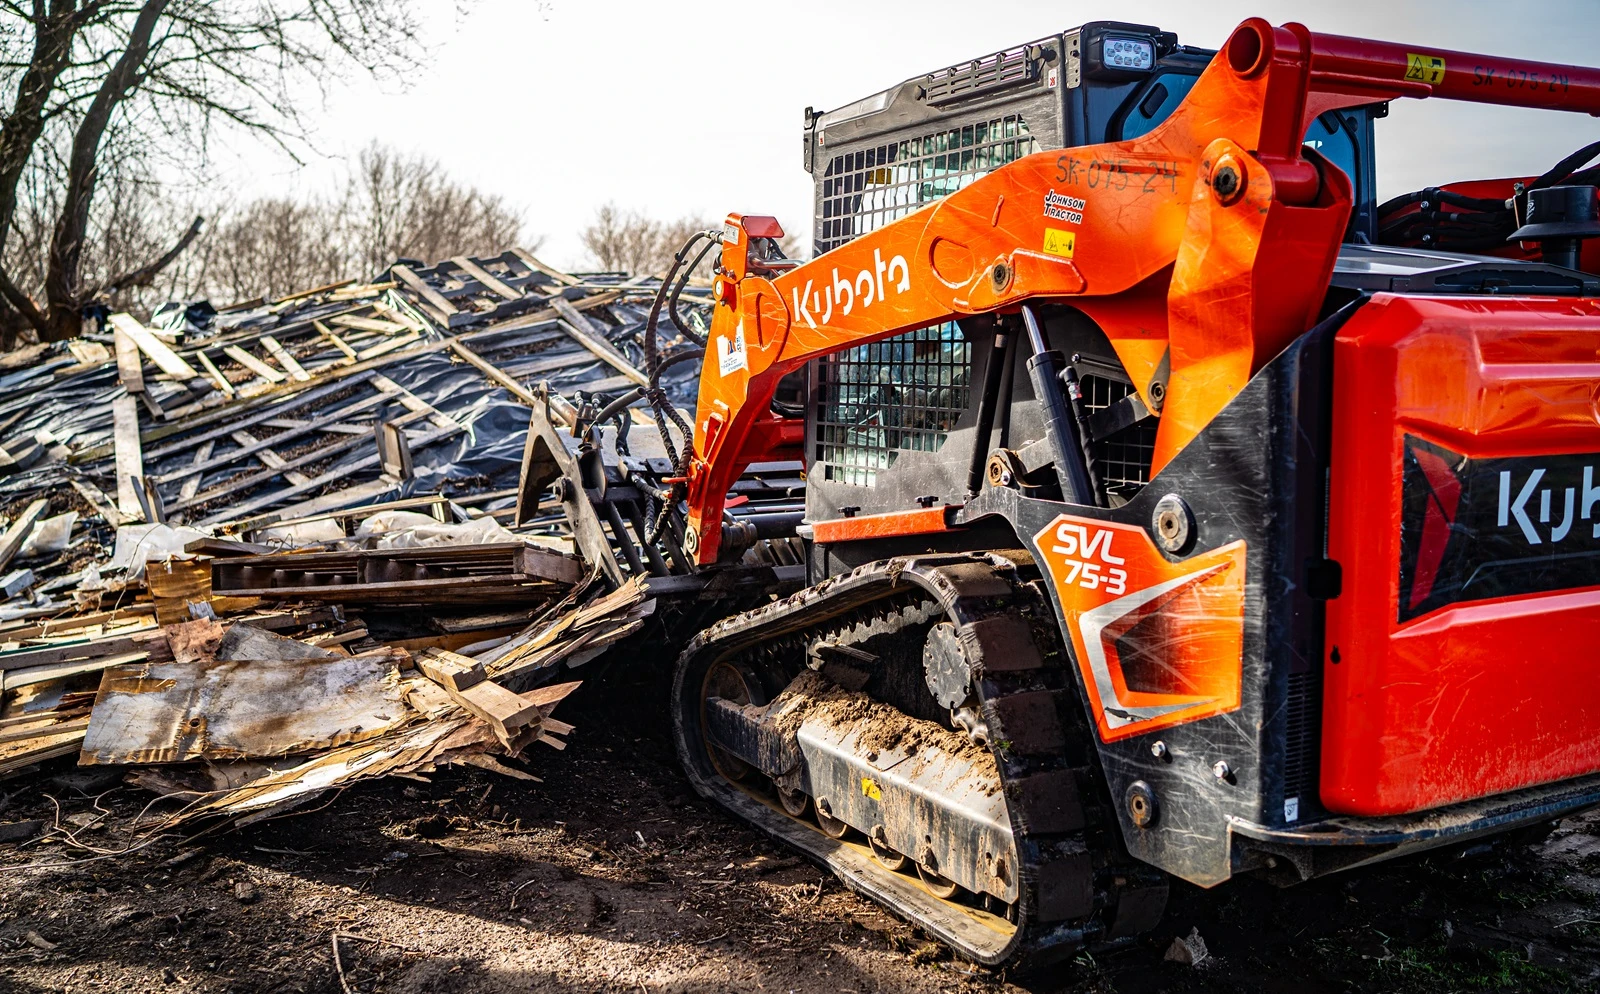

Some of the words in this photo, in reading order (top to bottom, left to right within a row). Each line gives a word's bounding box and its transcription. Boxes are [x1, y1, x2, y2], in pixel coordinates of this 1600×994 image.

[1472, 66, 1569, 92] SK-075-24
[1056, 156, 1177, 193] SK-075-24
[1045, 190, 1084, 210] JOHNSON
[1045, 204, 1082, 223] TRACTOR
[793, 248, 910, 329] Kubota
[1052, 523, 1125, 565] SVL
[1064, 559, 1128, 595] 75-3
